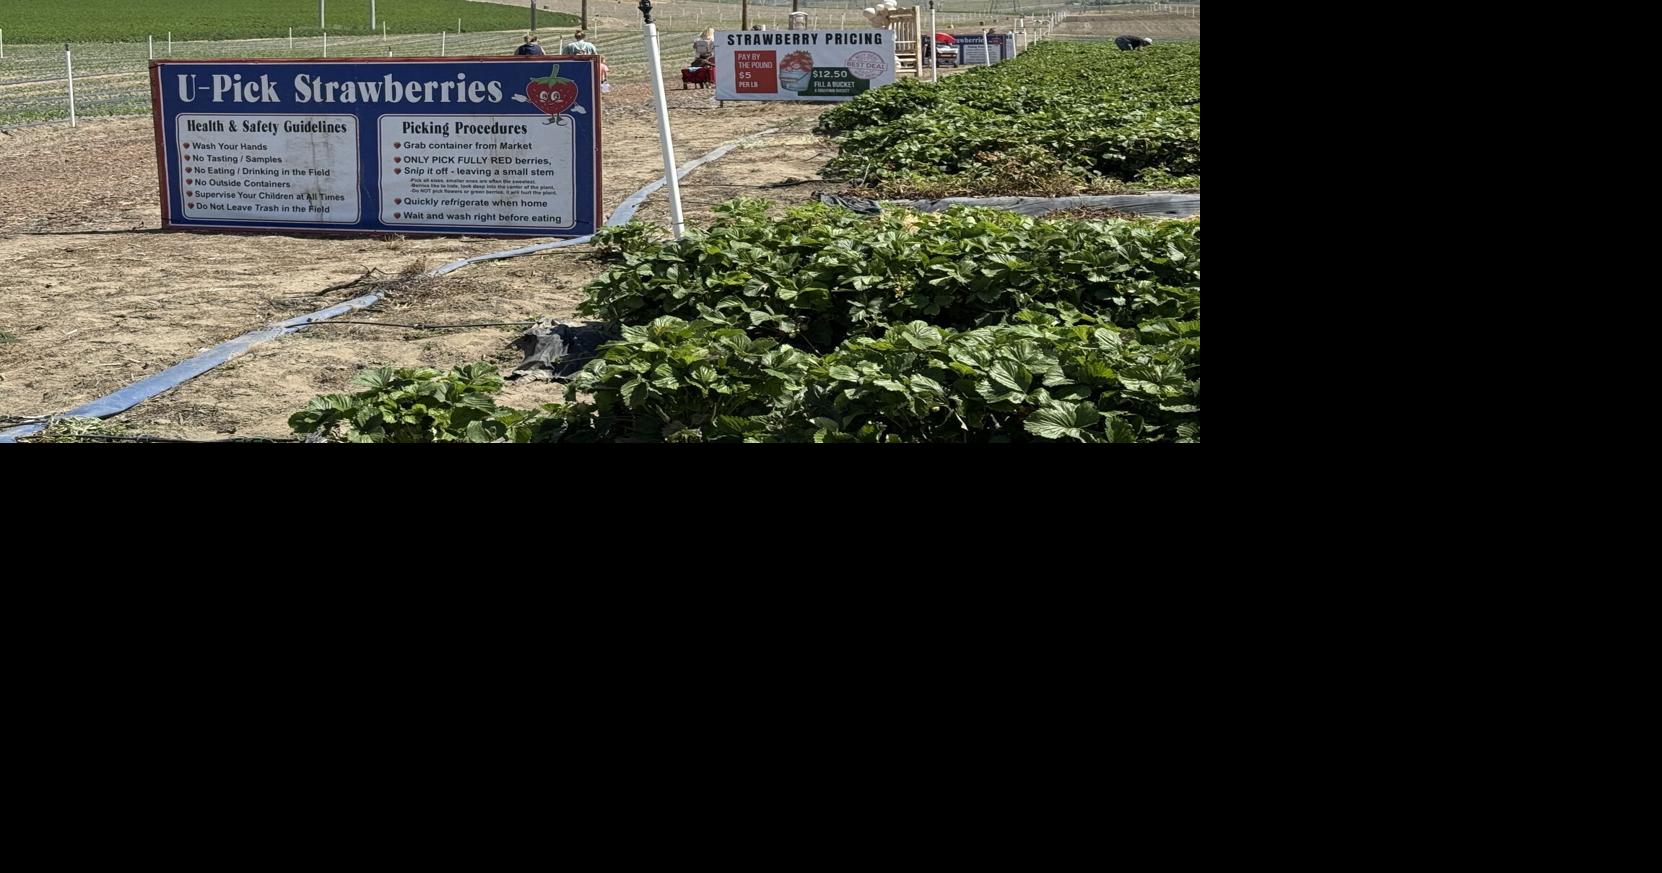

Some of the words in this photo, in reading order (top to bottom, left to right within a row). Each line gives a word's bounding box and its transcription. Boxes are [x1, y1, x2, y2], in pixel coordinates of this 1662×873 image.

[728, 34, 818, 45] STRAWBERRY
[826, 33, 882, 45] PRICING
[813, 70, 847, 79] $12.50
[178, 74, 280, 103] U-Pick
[295, 73, 503, 103] Strawberries
[187, 120, 223, 132] Health
[229, 120, 237, 132] &
[243, 120, 279, 135] Safety
[284, 120, 347, 133] Guidelines
[402, 122, 449, 137] Picking
[455, 122, 527, 134] Procedures
[207, 155, 238, 163] Tasting
[246, 156, 282, 164] Samples
[516, 158, 552, 166] berries,
[208, 167, 234, 176] Eating
[243, 168, 279, 176] Drinking
[404, 167, 424, 176] Snip
[457, 168, 491, 176] leaving
[195, 191, 236, 200] Supervise
[404, 198, 438, 206] Quickly
[442, 198, 489, 207] refrigerate
[474, 213, 496, 222] right
[499, 214, 529, 222] before
[532, 214, 561, 223] eating
